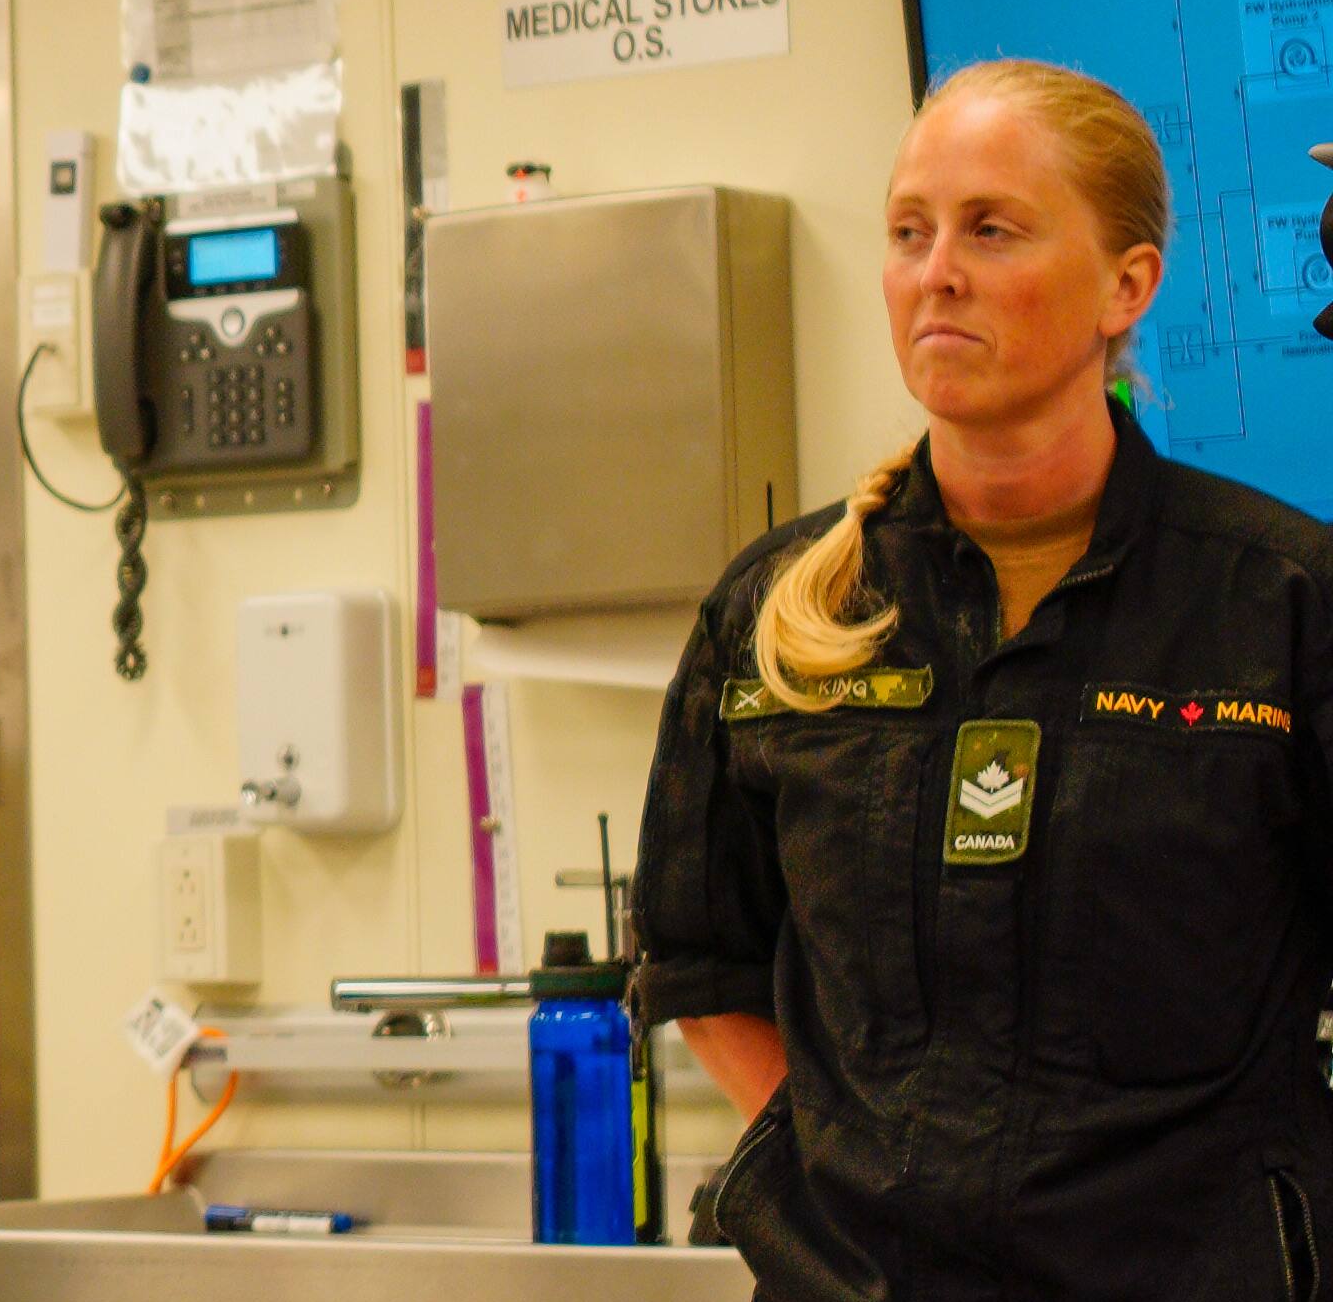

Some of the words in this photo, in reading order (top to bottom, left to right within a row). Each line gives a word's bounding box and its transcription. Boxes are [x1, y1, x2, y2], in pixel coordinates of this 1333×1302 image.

[612, 25, 672, 63] O.S.
[1095, 691, 1165, 719] NAVY
[954, 834, 1015, 851] CANADA
